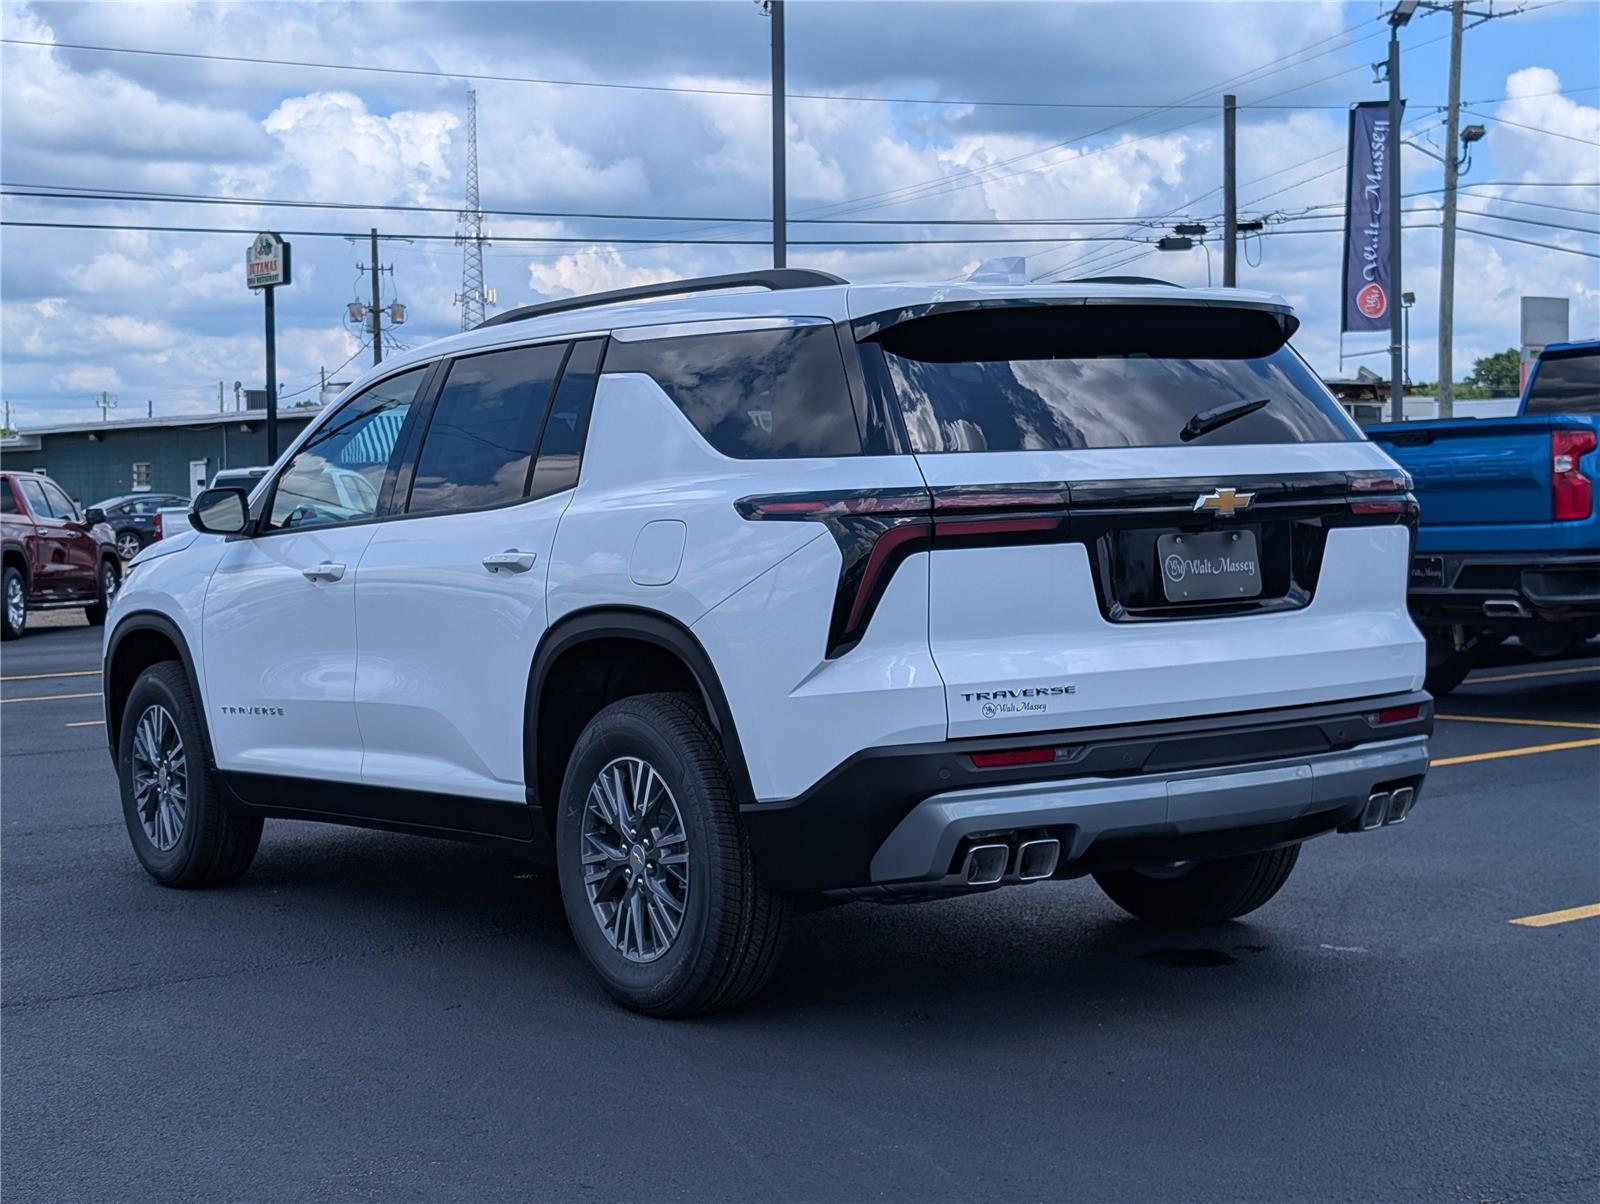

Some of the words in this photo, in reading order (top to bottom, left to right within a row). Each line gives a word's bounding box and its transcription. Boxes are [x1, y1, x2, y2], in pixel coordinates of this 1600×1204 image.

[1185, 560, 1211, 574] Walt
[1213, 557, 1255, 576] Massey
[960, 685, 1076, 702] TRAVERSE
[221, 706, 284, 716] TRAVERSE
[996, 704, 1015, 713] Walt
[1016, 702, 1047, 712] Massey
